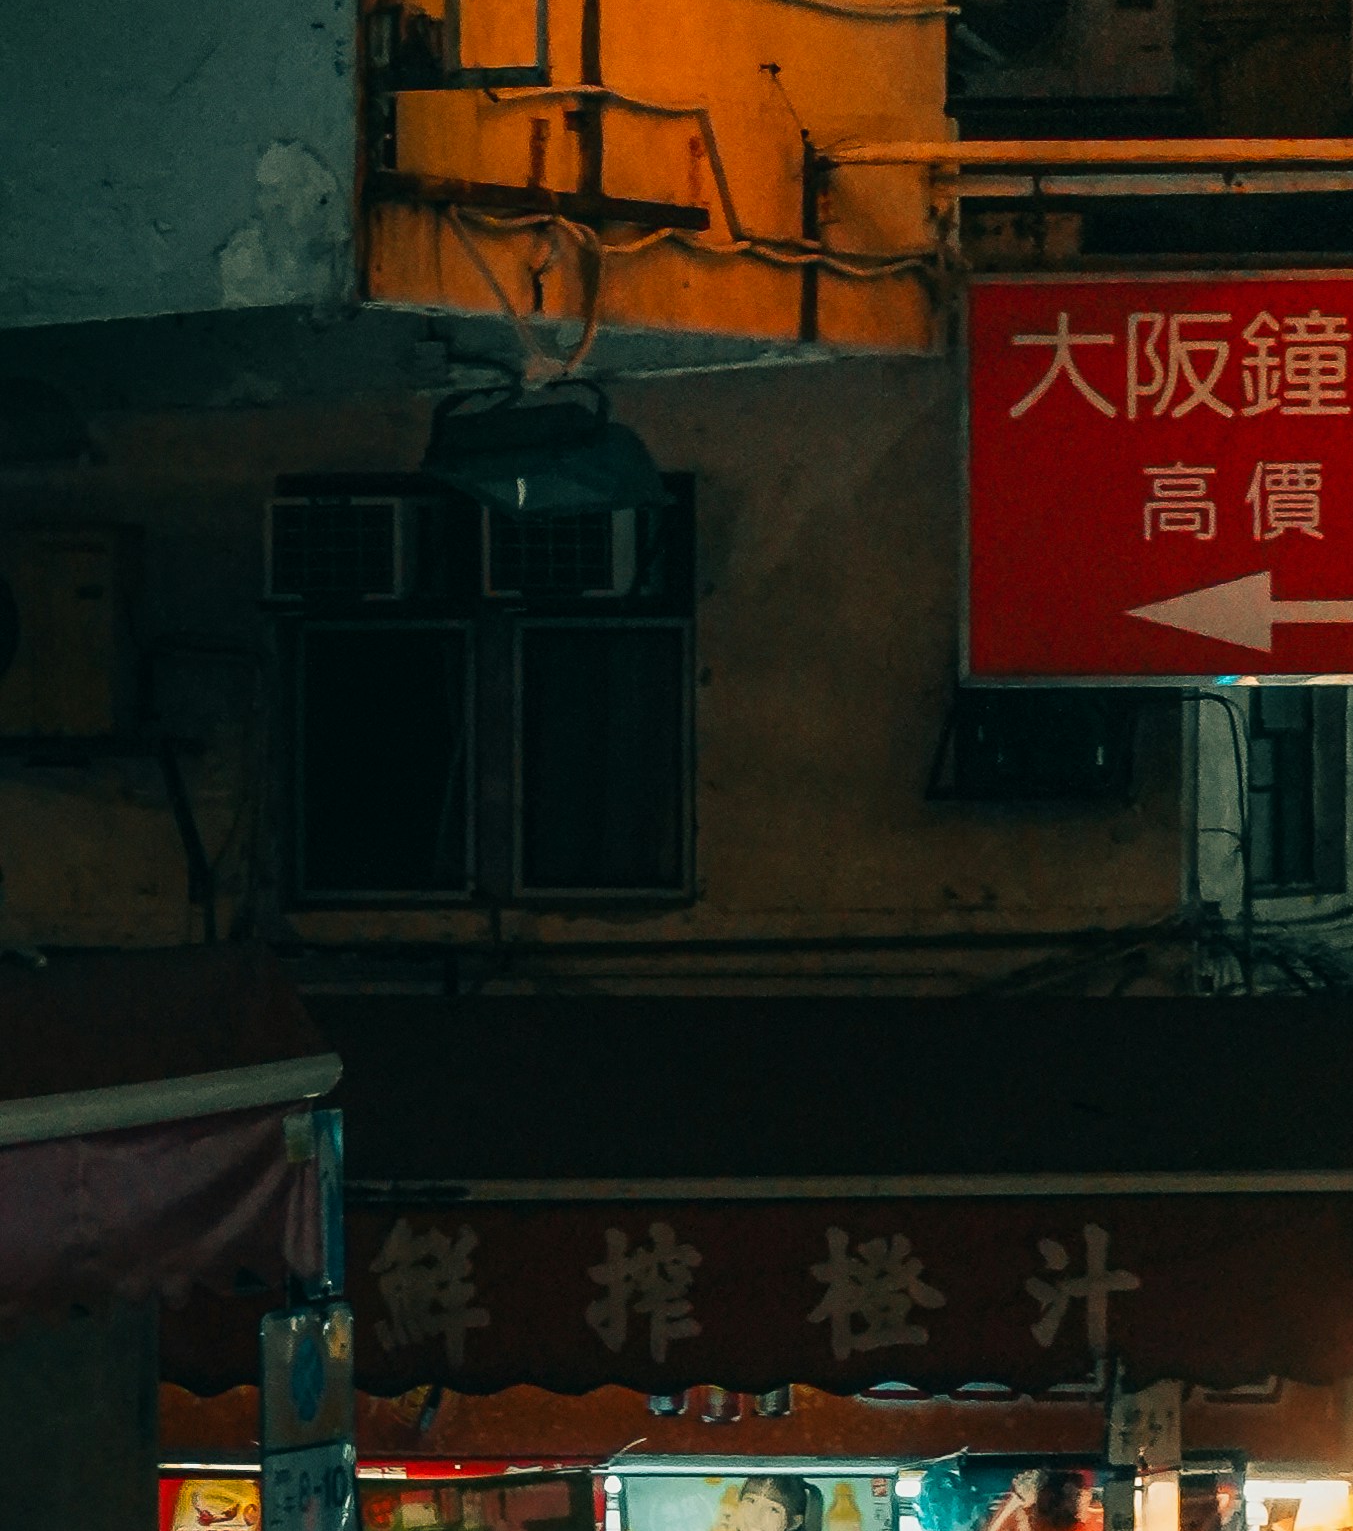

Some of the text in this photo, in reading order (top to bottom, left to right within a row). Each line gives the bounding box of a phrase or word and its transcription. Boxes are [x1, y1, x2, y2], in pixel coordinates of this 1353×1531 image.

[1142, 460, 1325, 542] 高價
[368, 1214, 1142, 1368] 鮮榨橙汁
